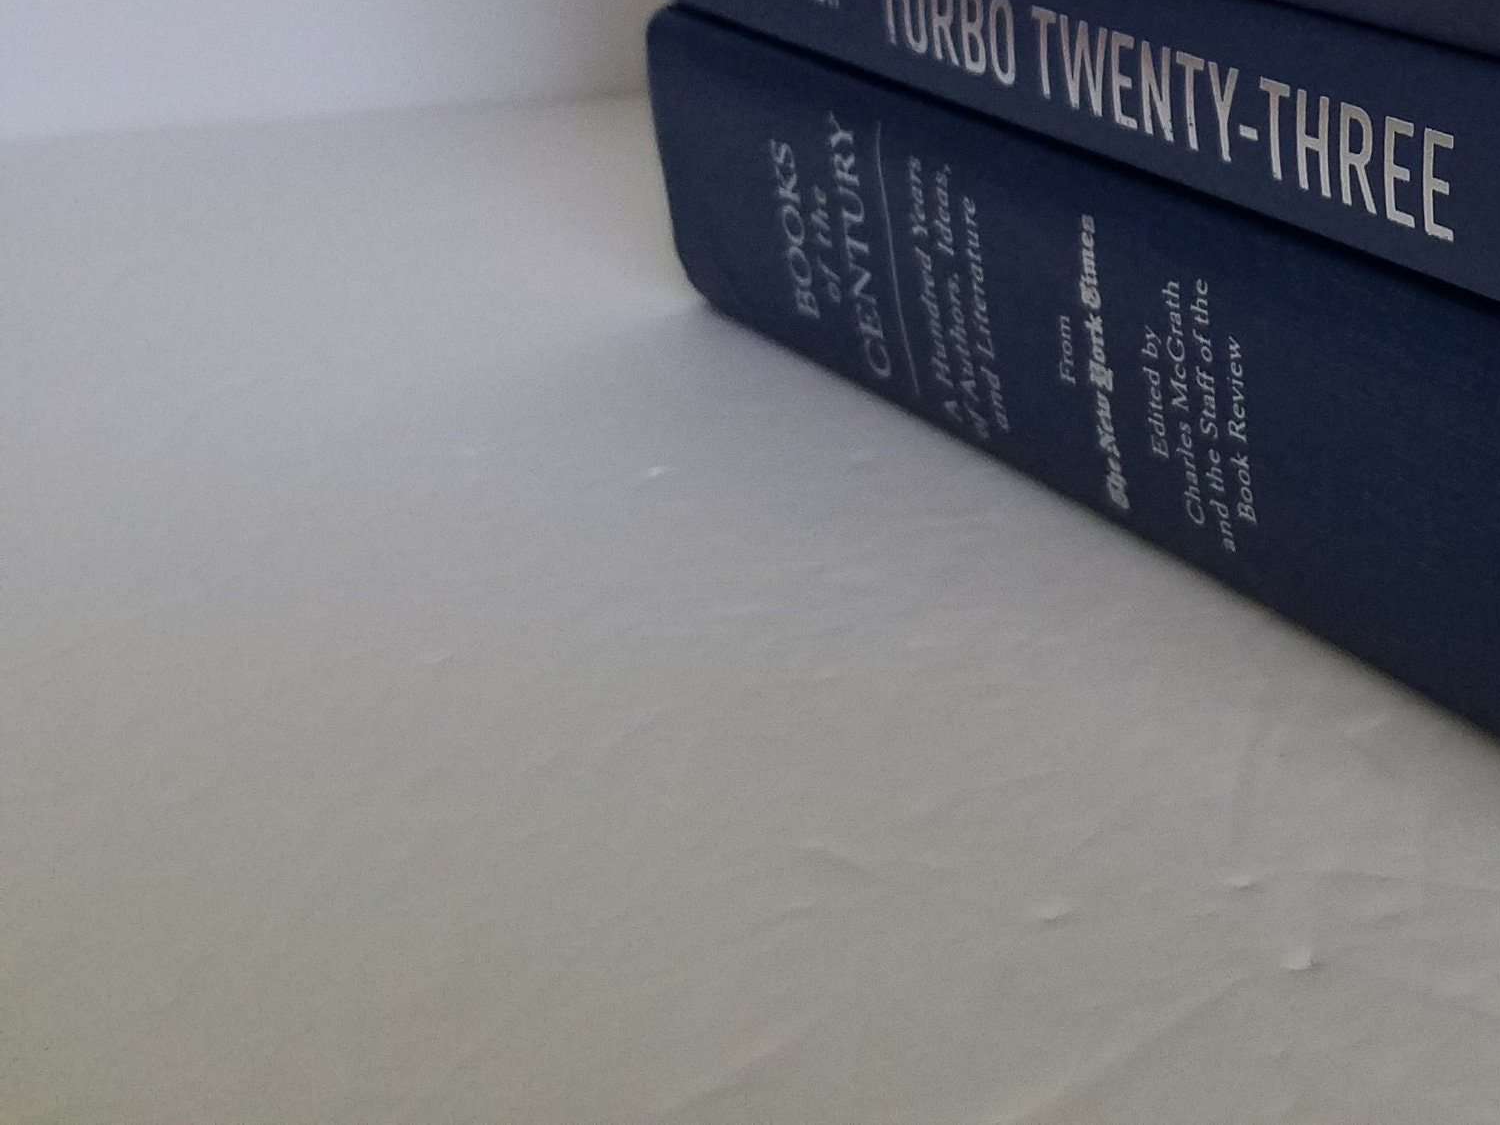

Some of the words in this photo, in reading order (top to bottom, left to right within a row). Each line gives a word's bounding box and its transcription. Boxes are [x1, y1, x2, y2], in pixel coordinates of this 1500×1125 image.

[1031, 7, 1456, 243] TWENTY-THREE
[770, 138, 821, 320] BOOKS
[810, 184, 834, 250] the
[907, 154, 928, 238] Years
[934, 164, 955, 257] Ideas,
[829, 111, 892, 377] CENTURY
[962, 196, 995, 361] Literature
[1080, 214, 1101, 310] Times
[914, 246, 954, 388] Hundred
[1141, 324, 1162, 360] by
[1190, 278, 1209, 325] the
[1058, 315, 1076, 385] From
[1085, 312, 1114, 392] York
[1162, 281, 1190, 412] McGrath
[1192, 328, 1214, 363] of
[981, 365, 1010, 432] and
[1096, 391, 1120, 455] New
[1147, 367, 1169, 460] Edited
[1195, 366, 1219, 439] Staff
[1227, 336, 1248, 444] Review
[1176, 422, 1205, 525] Charles
[1205, 448, 1227, 494] the
[1236, 454, 1257, 525] Book
[1210, 500, 1236, 553] and
